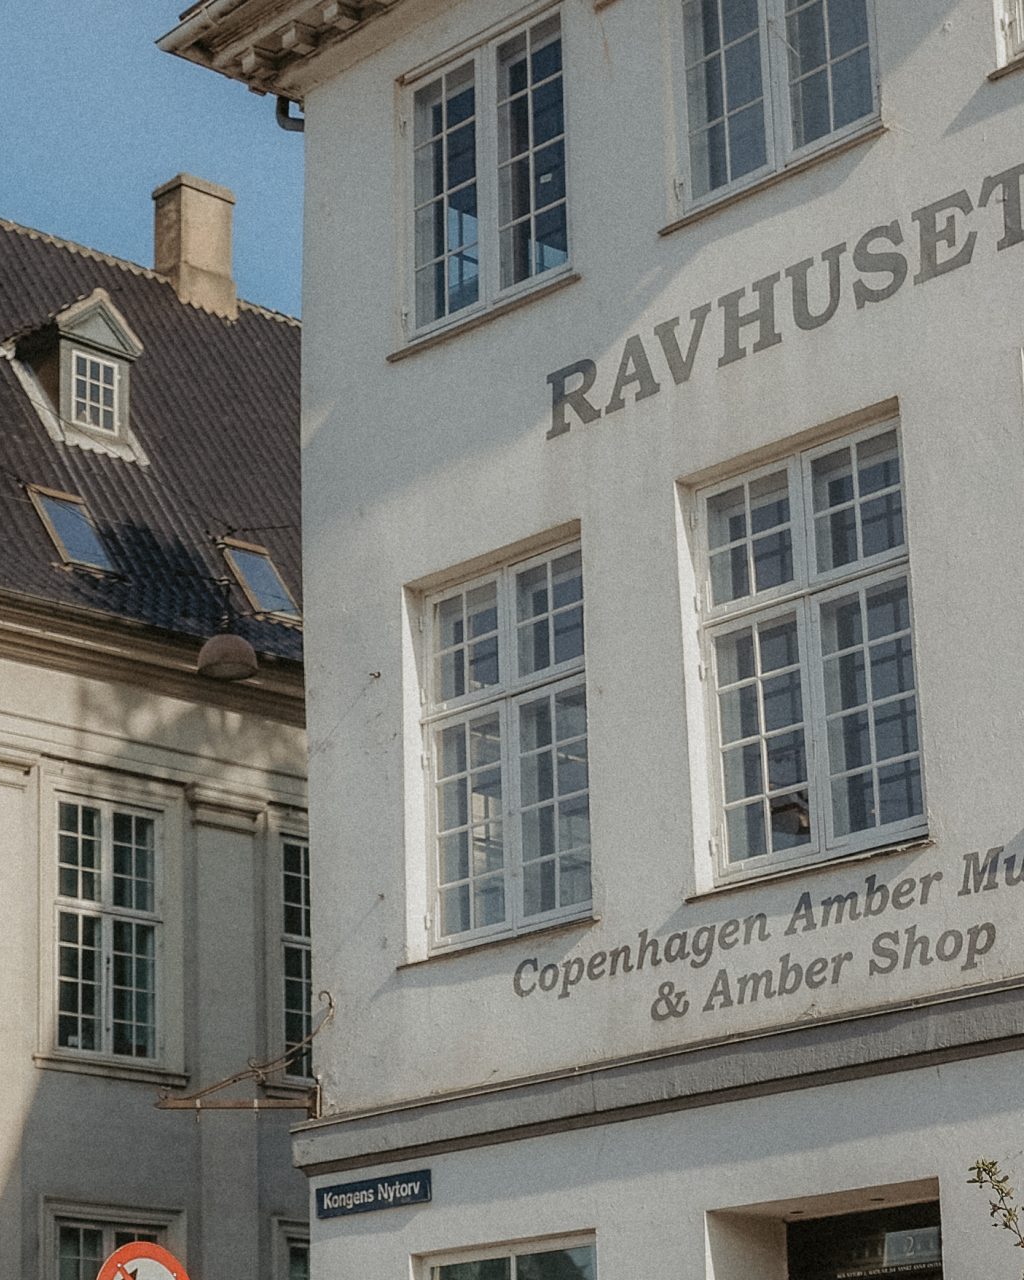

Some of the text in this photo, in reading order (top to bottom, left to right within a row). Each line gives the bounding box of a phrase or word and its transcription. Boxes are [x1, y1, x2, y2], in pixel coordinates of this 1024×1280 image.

[546, 163, 1024, 440] RAVHUSET
[513, 910, 769, 1000] Copenhagen
[784, 868, 943, 935] Amber
[650, 919, 996, 1021] & Amber Shop
[323, 1180, 421, 1210] Kongens Nytorv
